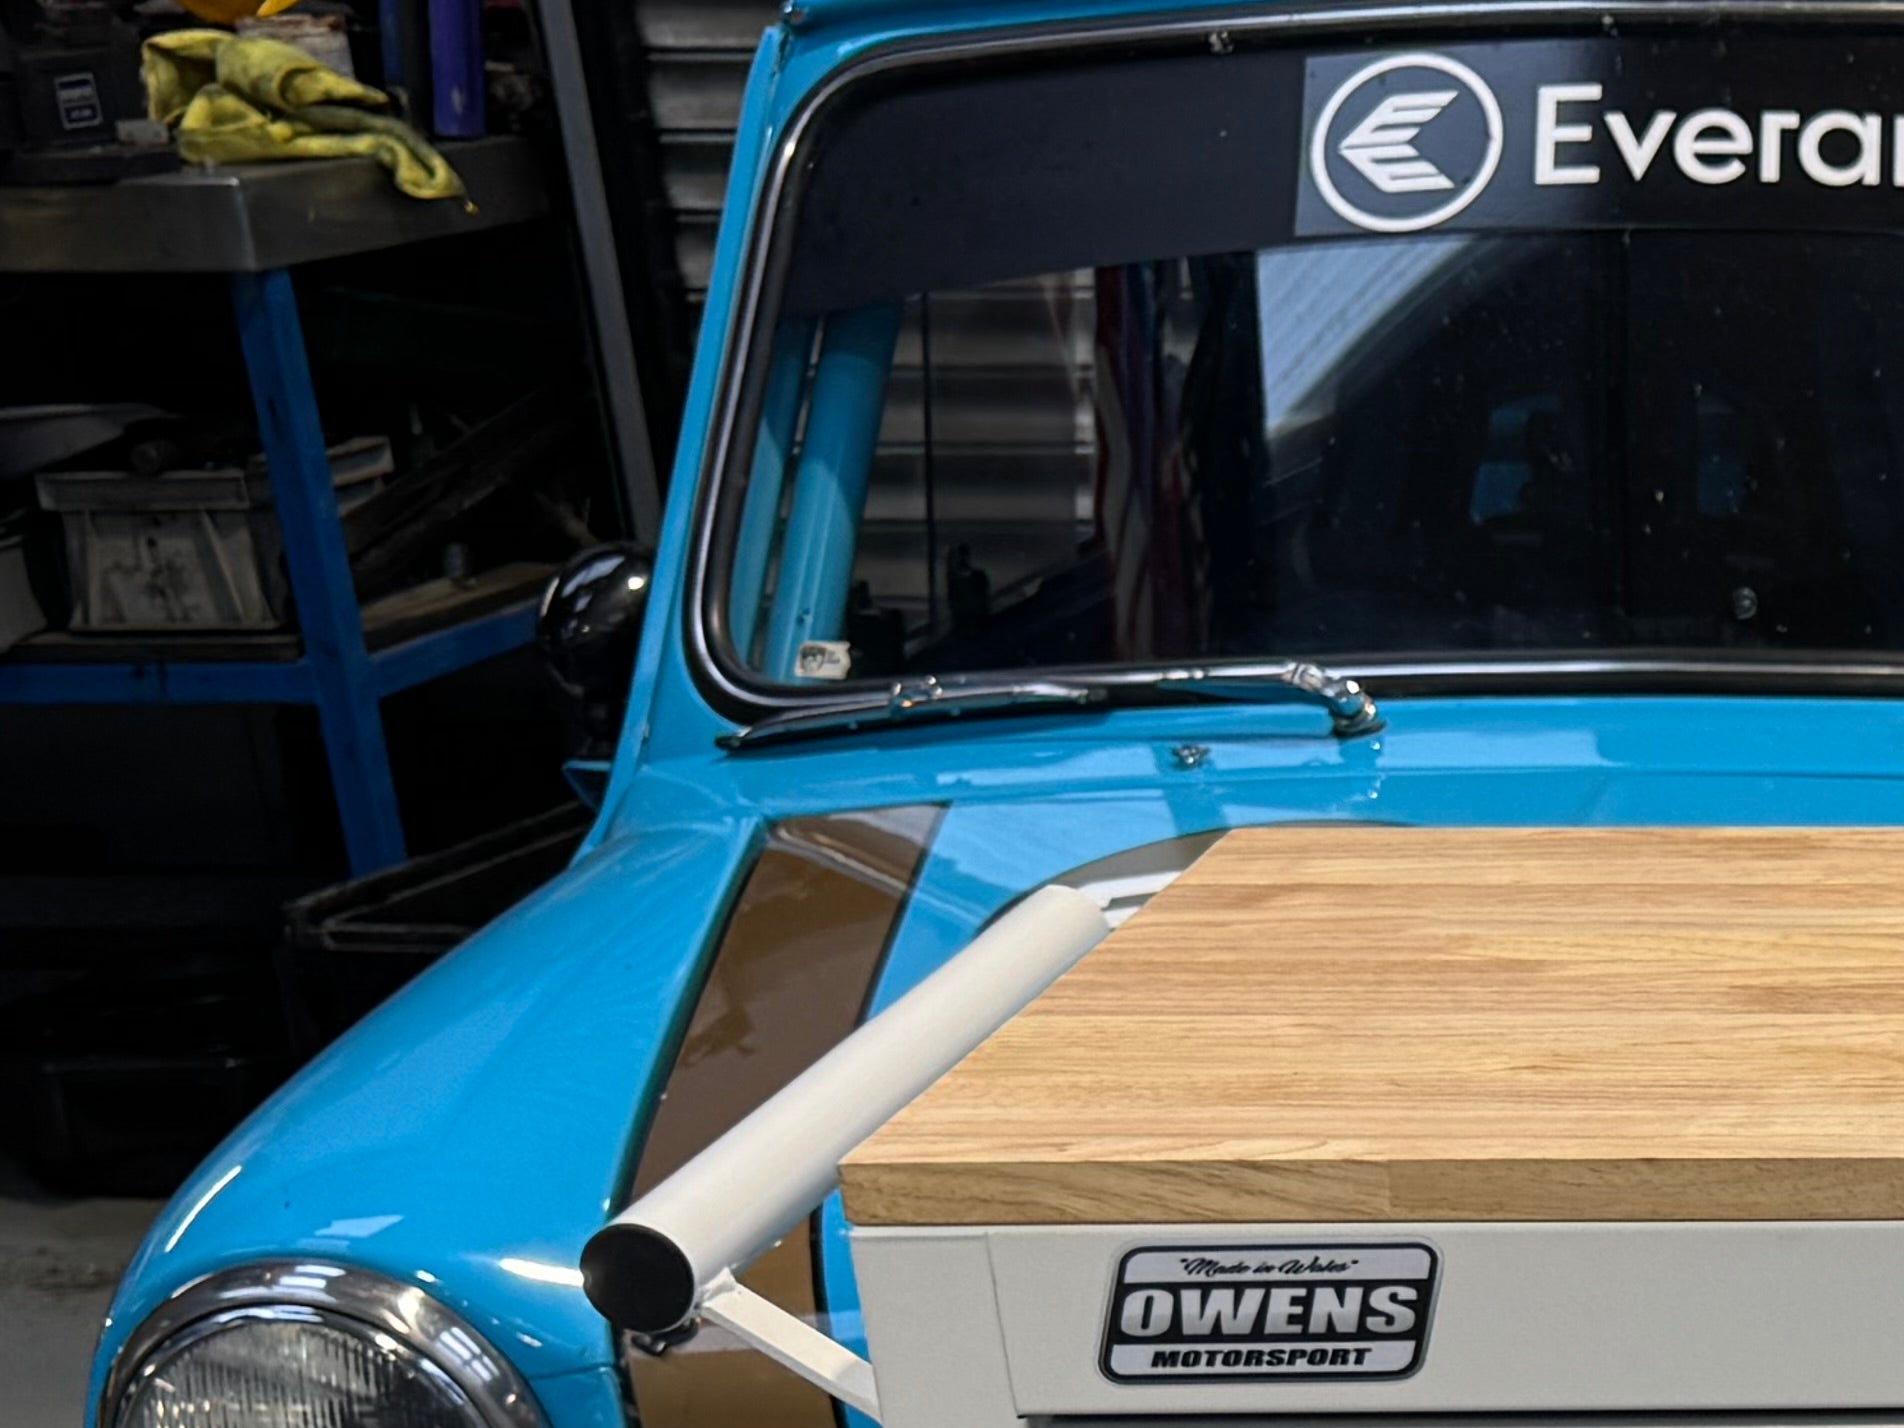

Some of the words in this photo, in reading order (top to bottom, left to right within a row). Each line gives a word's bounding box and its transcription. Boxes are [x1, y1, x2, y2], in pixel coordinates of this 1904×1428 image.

[1252, 1260, 1276, 1275] in
[1120, 1286, 1419, 1337] OWENS
[1151, 1347, 1373, 1368] MOTORSPORT
